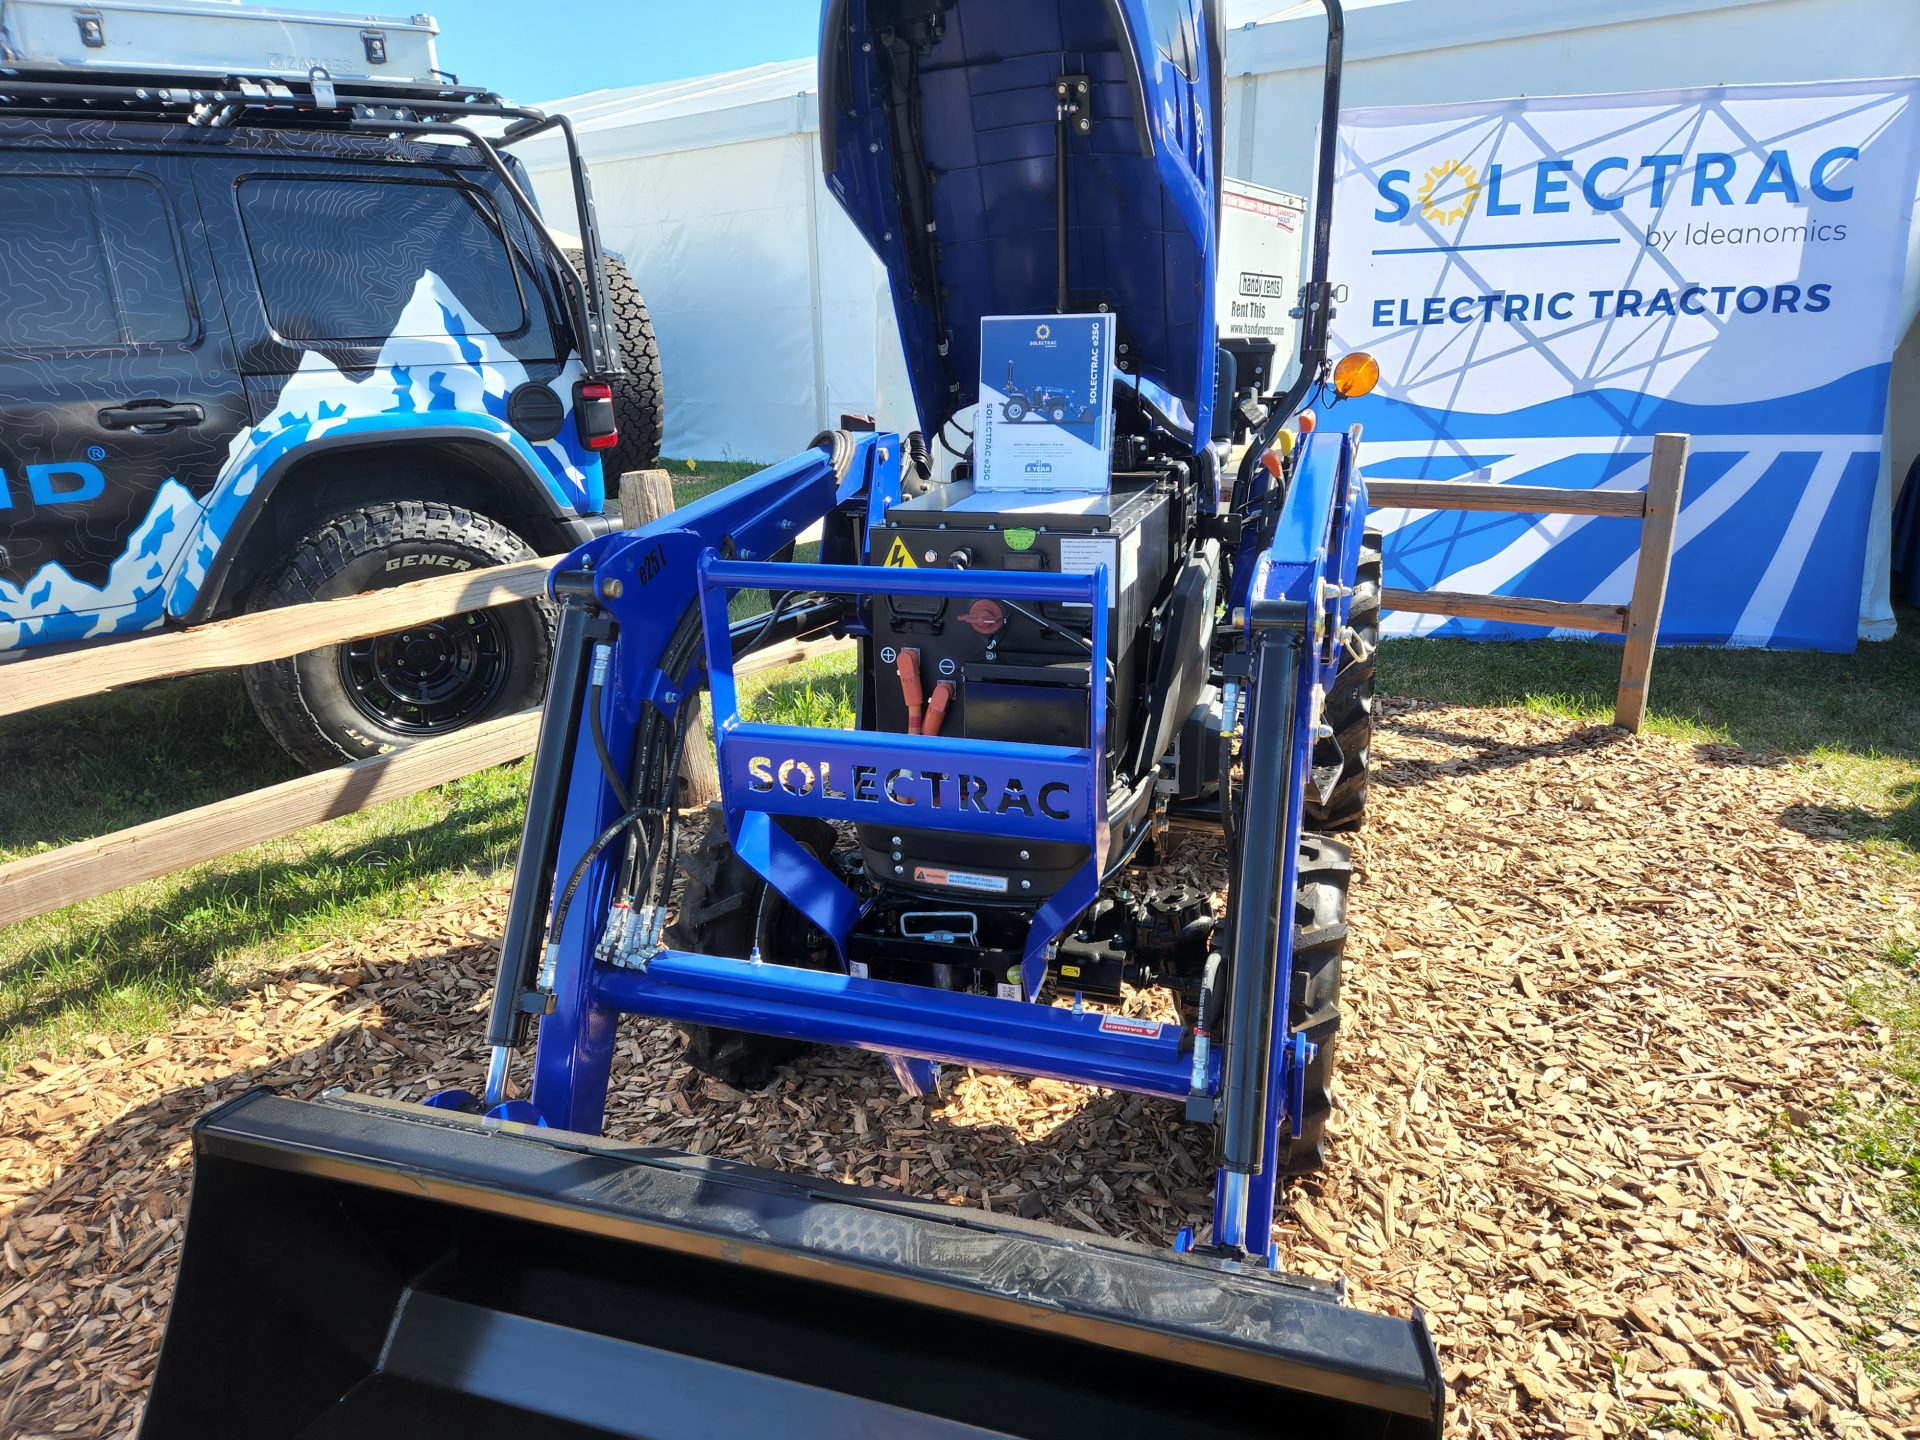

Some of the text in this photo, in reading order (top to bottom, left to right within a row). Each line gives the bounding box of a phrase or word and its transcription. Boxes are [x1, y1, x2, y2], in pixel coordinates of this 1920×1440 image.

[1374, 146, 1860, 224] SOLECTRAC
[1645, 219, 1848, 252] by Ideanomics
[1242, 273, 1281, 297] handy rents
[1231, 301, 1266, 319] Rent This
[1372, 283, 1833, 327] ELECTRIC TRACTORS
[1230, 322, 1285, 336] www.handyrents.com
[1089, 322, 1100, 405] SOLECTRAC e25G
[984, 402, 993, 457] SOLECTRAC
[385, 553, 472, 572] GENER
[748, 756, 1071, 820] SOLECTRAC
[1105, 1024, 1143, 1033] DANGER
